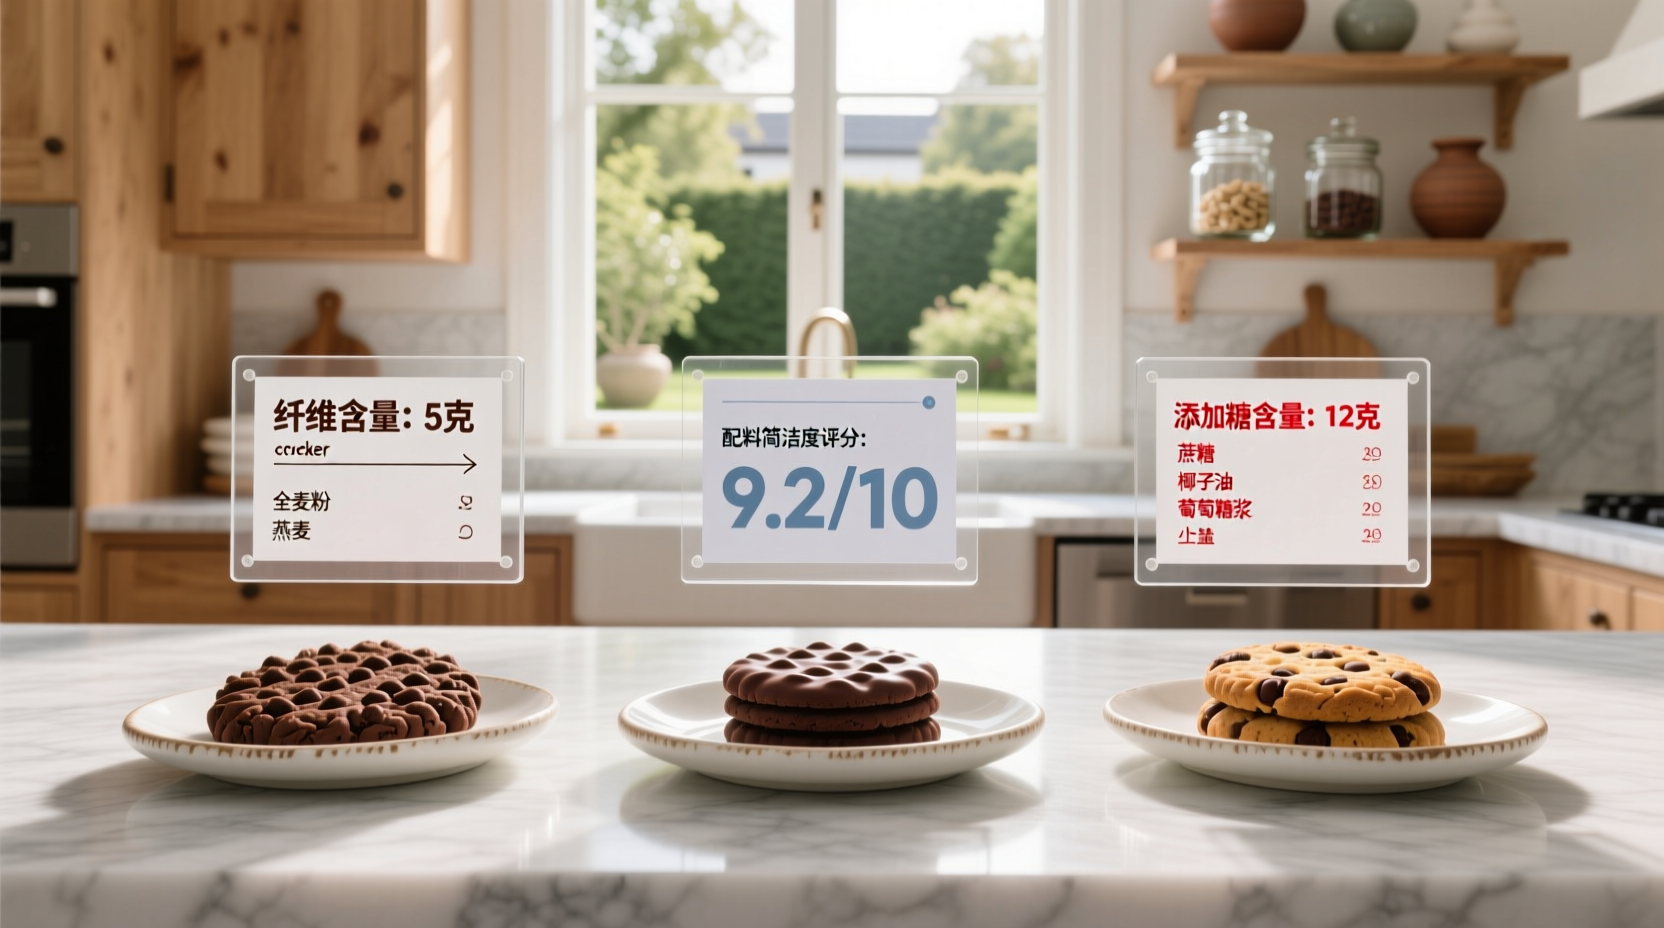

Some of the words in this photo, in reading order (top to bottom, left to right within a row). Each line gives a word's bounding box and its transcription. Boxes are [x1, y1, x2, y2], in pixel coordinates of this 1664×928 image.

[1178, 442, 1215, 464] 蔗糖
[1178, 471, 1233, 491] 椰子油
[273, 490, 331, 512] 全麦粉
[722, 465, 938, 531] 9.2/10
[272, 520, 311, 541] 燕麦
